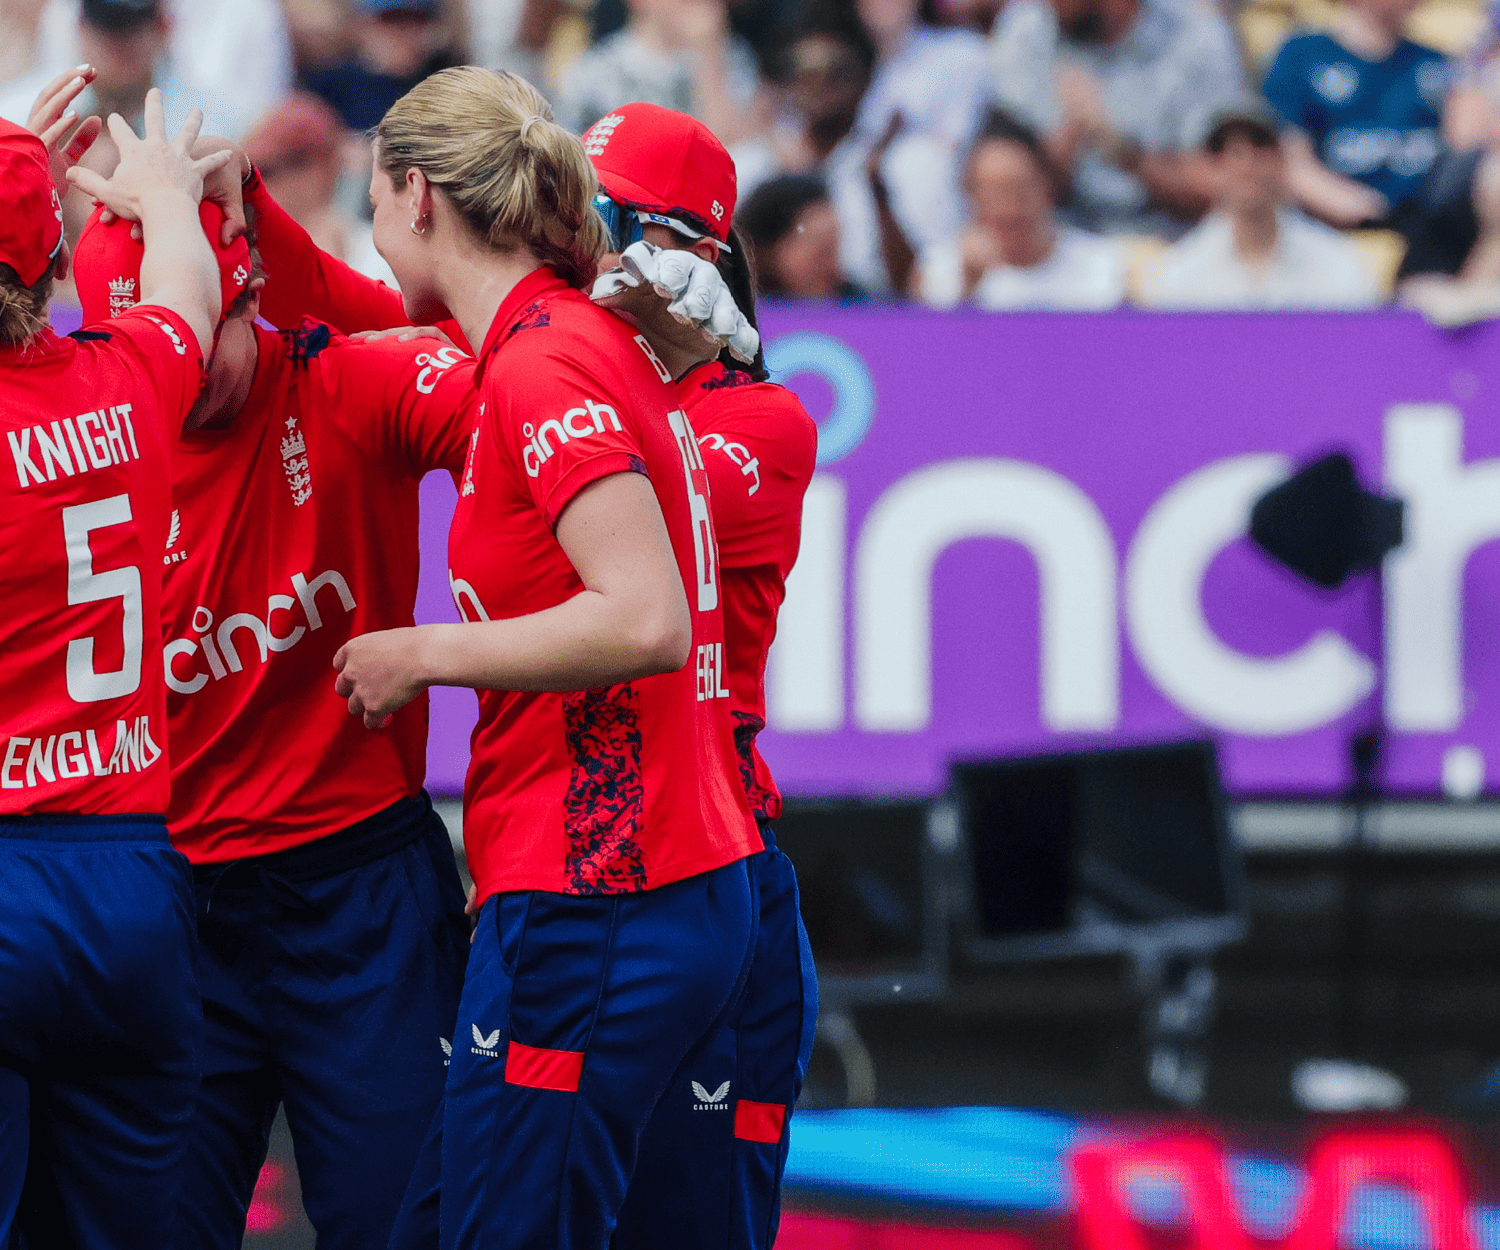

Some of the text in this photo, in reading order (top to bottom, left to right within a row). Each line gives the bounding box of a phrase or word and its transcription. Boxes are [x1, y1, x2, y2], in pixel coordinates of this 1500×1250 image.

[711, 200, 724, 221] 52
[233, 265, 247, 285] 33
[415, 347, 473, 394] cin
[7, 403, 140, 488] KNIGHT
[522, 399, 623, 478] cinch
[696, 433, 760, 497] nch
[762, 332, 1500, 736] inch
[62, 493, 143, 704] 5
[162, 569, 357, 694] cinch
[1, 715, 162, 789] ENGLAND
[693, 1103, 729, 1111] CASTORE
